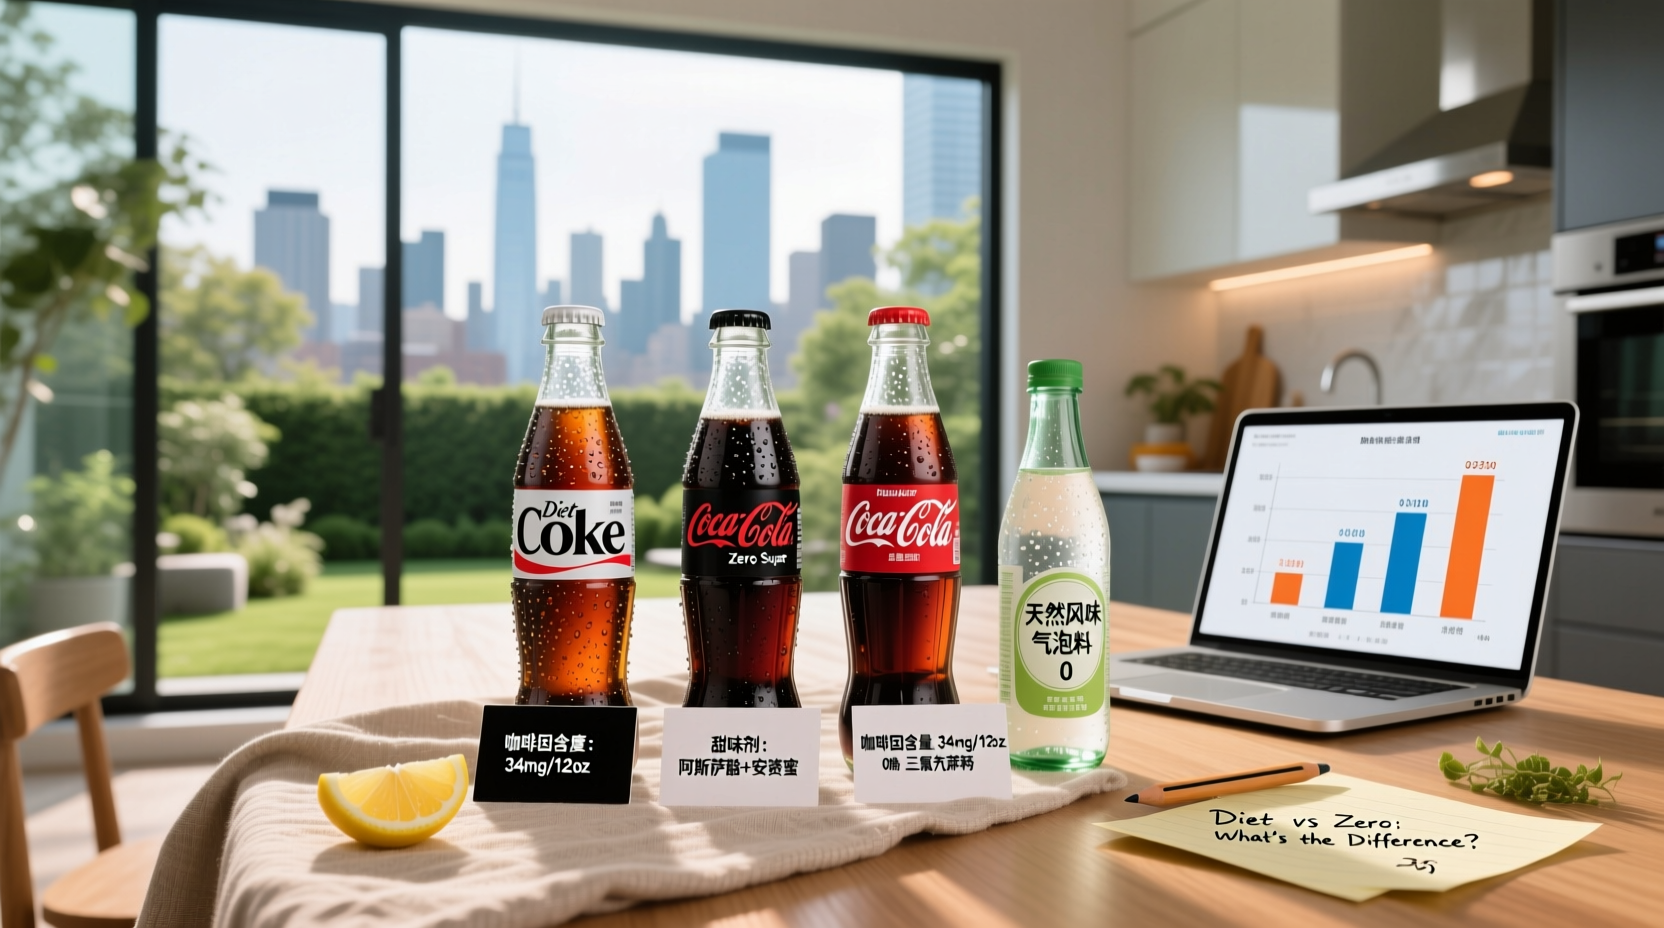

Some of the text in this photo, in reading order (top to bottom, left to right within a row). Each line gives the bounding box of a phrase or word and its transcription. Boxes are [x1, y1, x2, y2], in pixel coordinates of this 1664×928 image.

[542, 501, 578, 518] Diet
[517, 507, 625, 556] Coke
[687, 501, 798, 548] Coca-Cola
[845, 498, 957, 548] Coca-Cola
[728, 552, 757, 565] Zero
[1025, 600, 1102, 626] 天然风味
[1031, 630, 1093, 655] 气泡料
[1060, 661, 1073, 681] 0
[504, 756, 591, 777] 34mg/12oz
[1209, 809, 1401, 830] Diet vs Zero:
[1214, 829, 1480, 850] What's the Difference?
